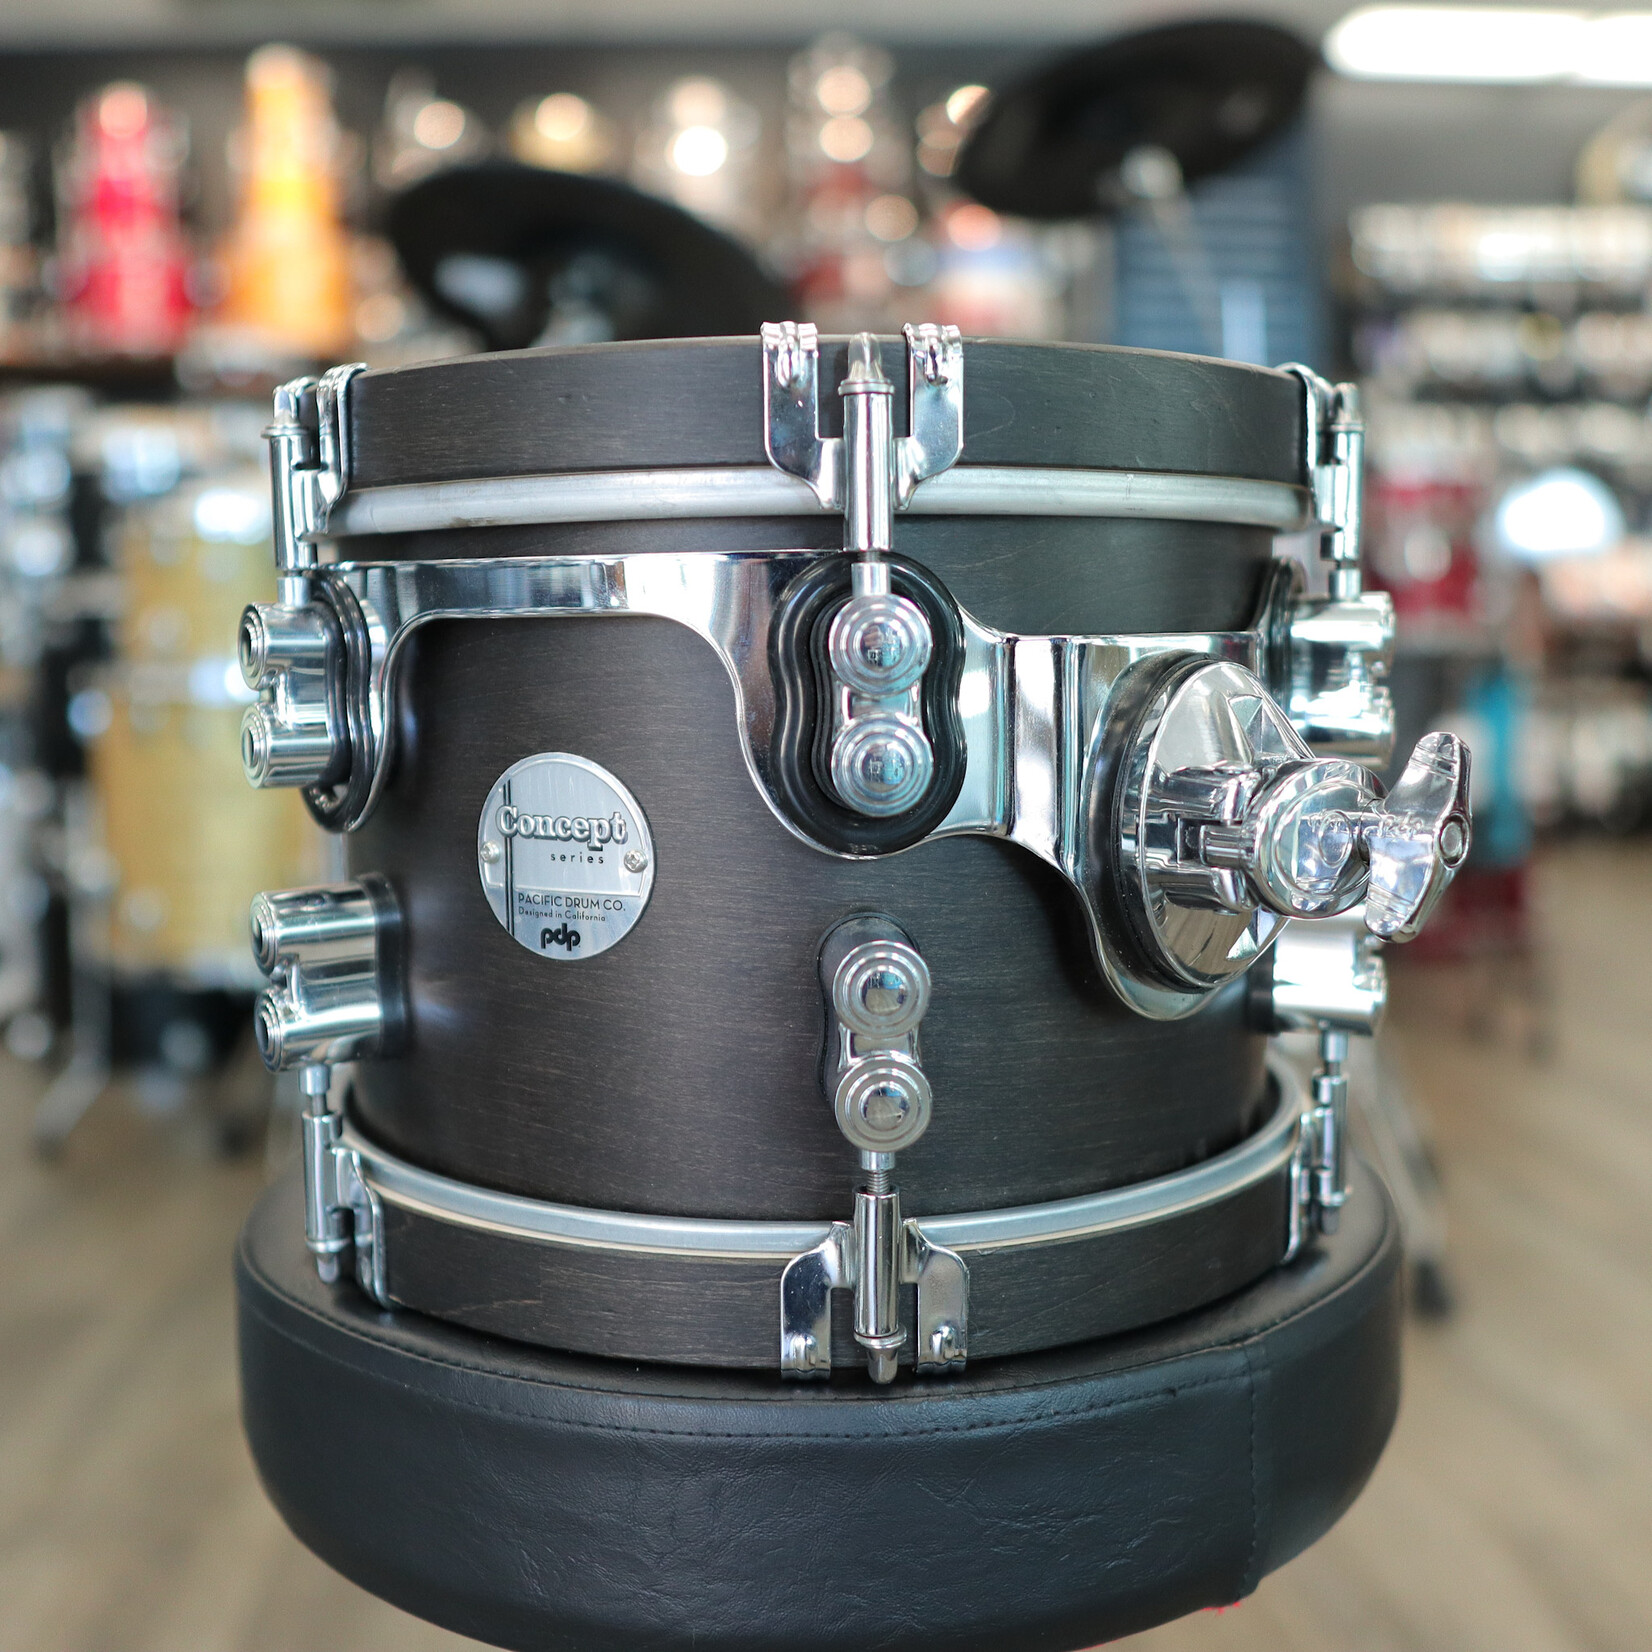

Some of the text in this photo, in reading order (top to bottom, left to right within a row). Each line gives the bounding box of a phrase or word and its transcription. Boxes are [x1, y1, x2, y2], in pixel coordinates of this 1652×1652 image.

[496, 805, 628, 851] Concept
[551, 852, 603, 864] series
[518, 893, 626, 911] PACIFIC DRUM CO.
[518, 906, 553, 918] Designed
[565, 911, 606, 921] California
[541, 923, 580, 951] pdp
